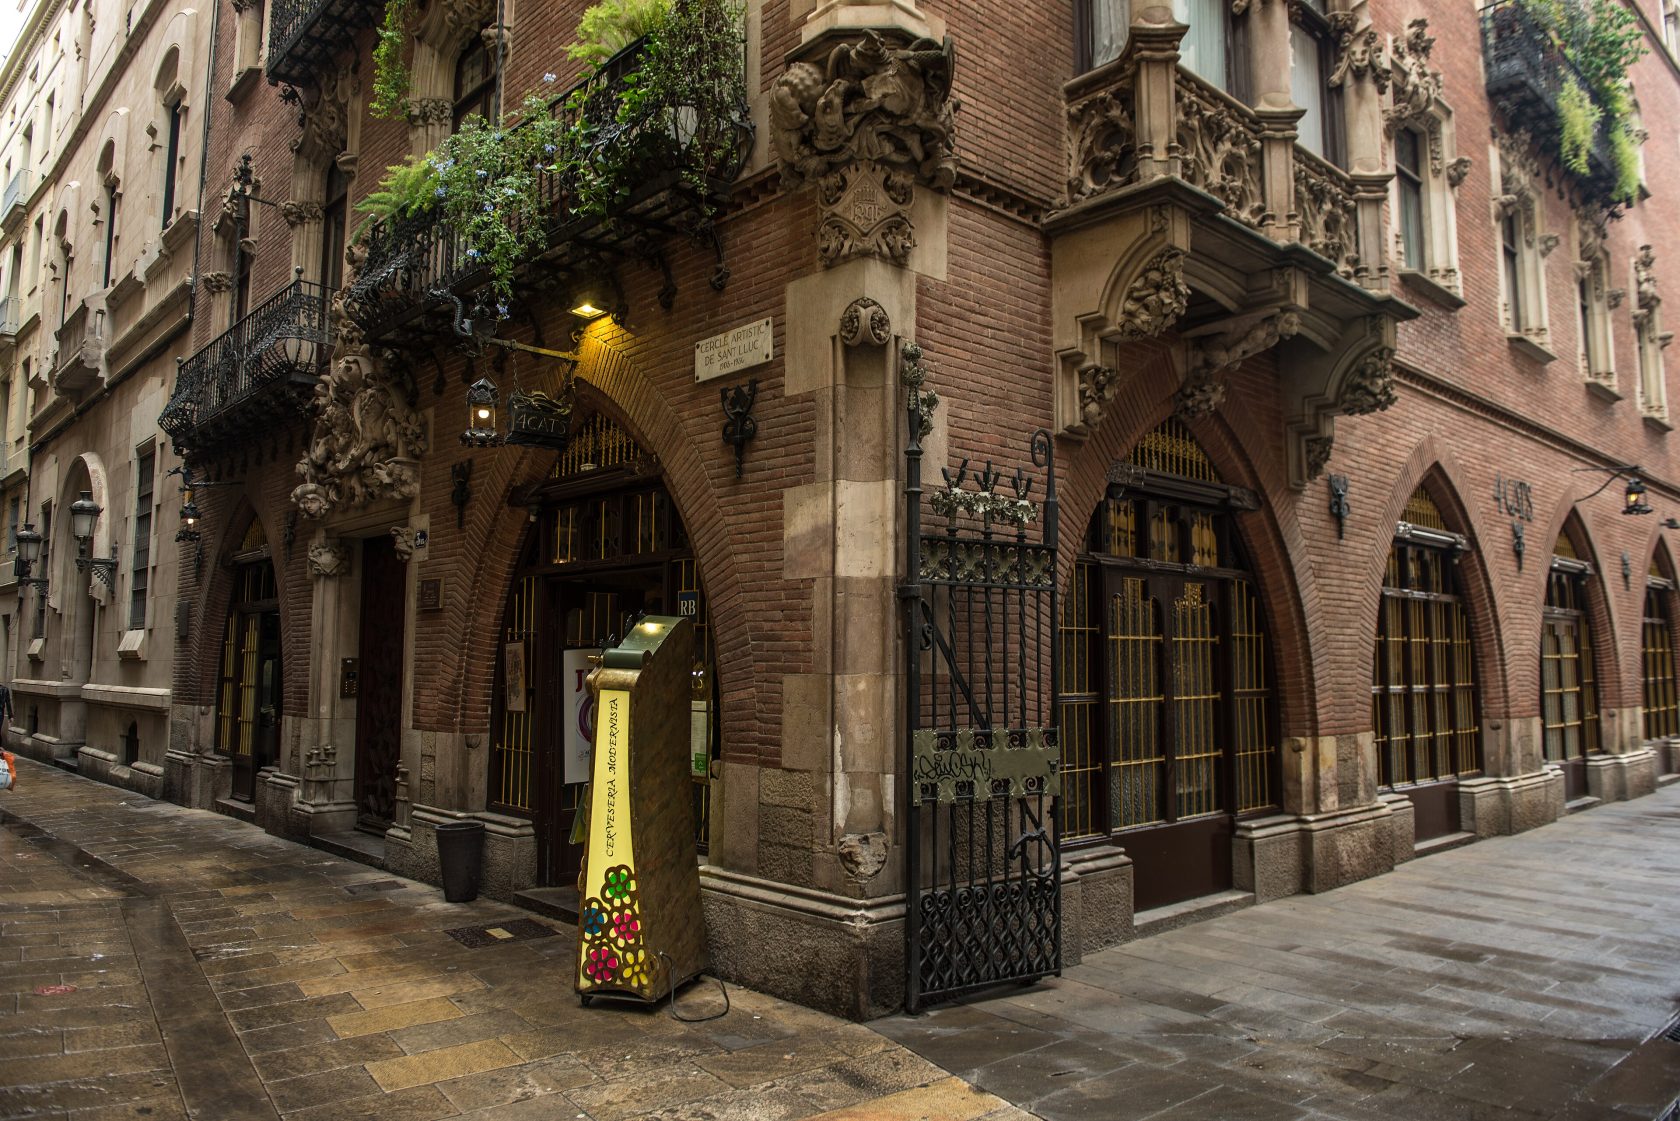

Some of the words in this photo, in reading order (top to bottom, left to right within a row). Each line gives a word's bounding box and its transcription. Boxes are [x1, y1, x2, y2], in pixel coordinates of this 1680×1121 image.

[700, 335, 729, 354] CERCLE
[704, 354, 715, 367] DE
[717, 346, 737, 362] SANT
[738, 339, 759, 356] LLUC
[680, 600, 696, 616] RB
[608, 697, 619, 776] MODERNISTA
[605, 778, 617, 858] CERVESERIA
